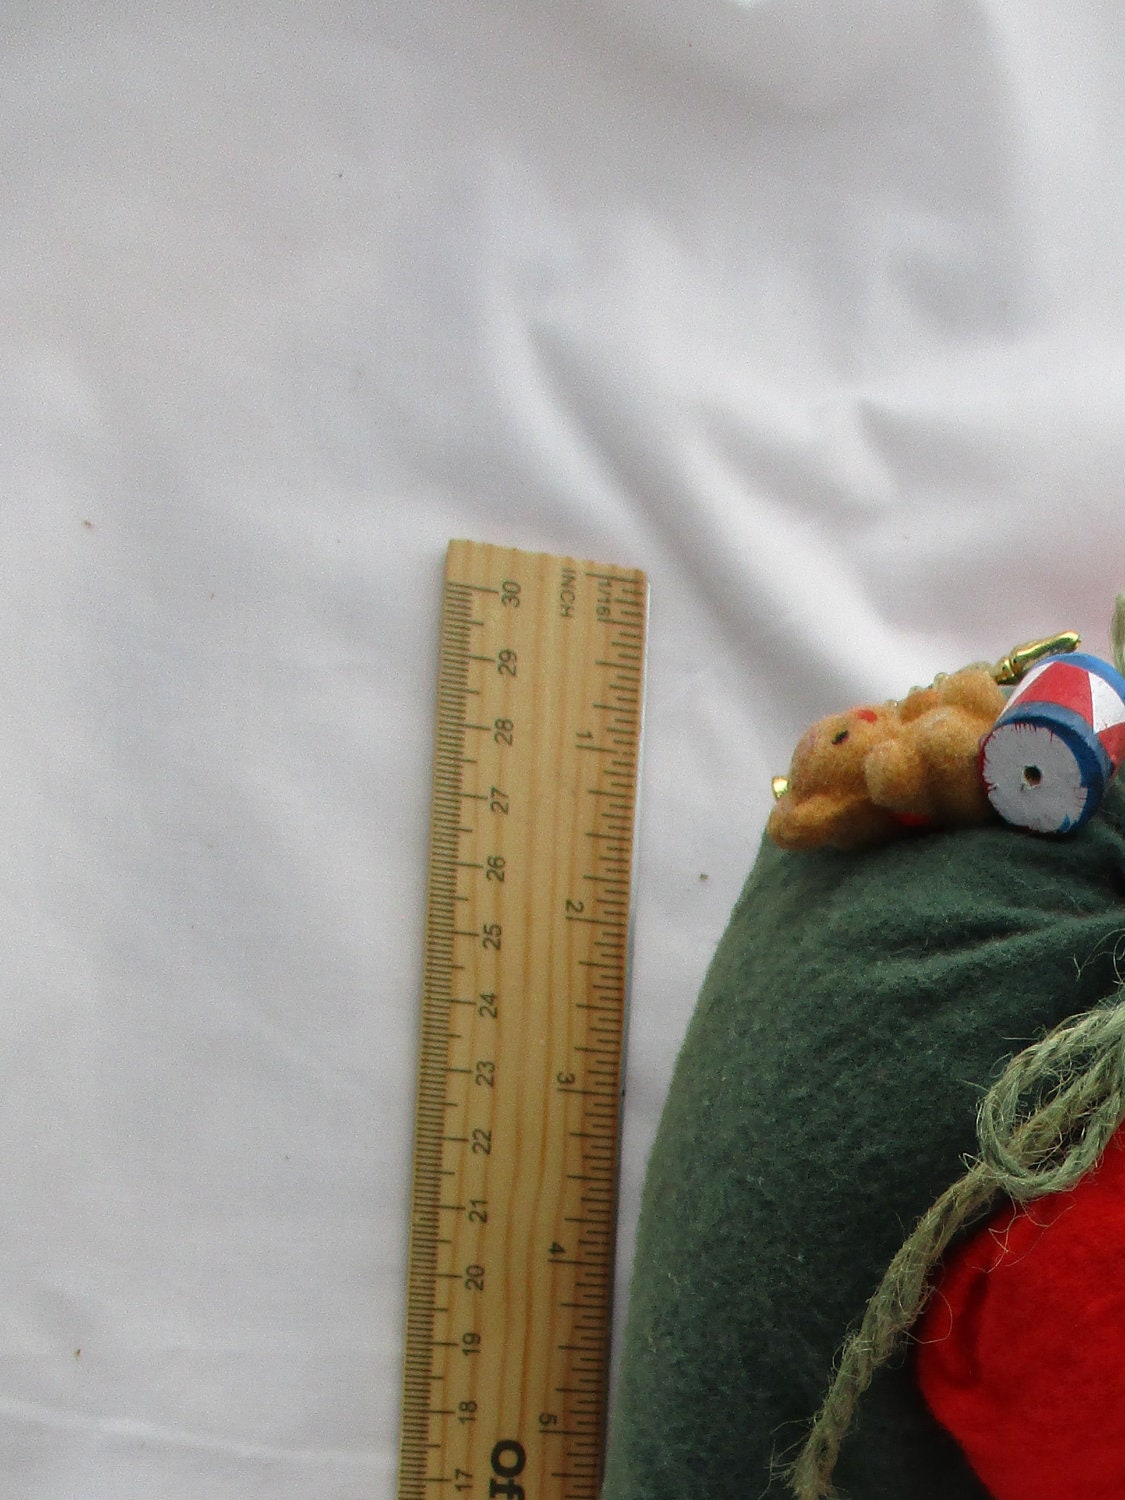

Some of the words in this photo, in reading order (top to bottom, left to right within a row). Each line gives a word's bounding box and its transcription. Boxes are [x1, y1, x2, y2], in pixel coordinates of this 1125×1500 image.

[501, 580, 522, 608] 30
[560, 567, 576, 618] INCH
[497, 648, 517, 677] 29
[493, 718, 514, 746] 28
[575, 730, 594, 740] 1
[490, 787, 509, 815] 27
[486, 856, 506, 882] 26
[565, 899, 584, 914] 2
[482, 923, 502, 950] 25
[478, 992, 498, 1019] 24
[475, 1060, 495, 1088] 23
[557, 1072, 575, 1085] 3
[472, 1128, 492, 1155] 22
[469, 1198, 488, 1224] 21
[548, 1242, 566, 1254] 4
[465, 1265, 485, 1291] 20
[462, 1332, 481, 1356] 19
[459, 1400, 478, 1424] 18
[539, 1412, 557, 1425] 5
[454, 1468, 473, 1492] 17
